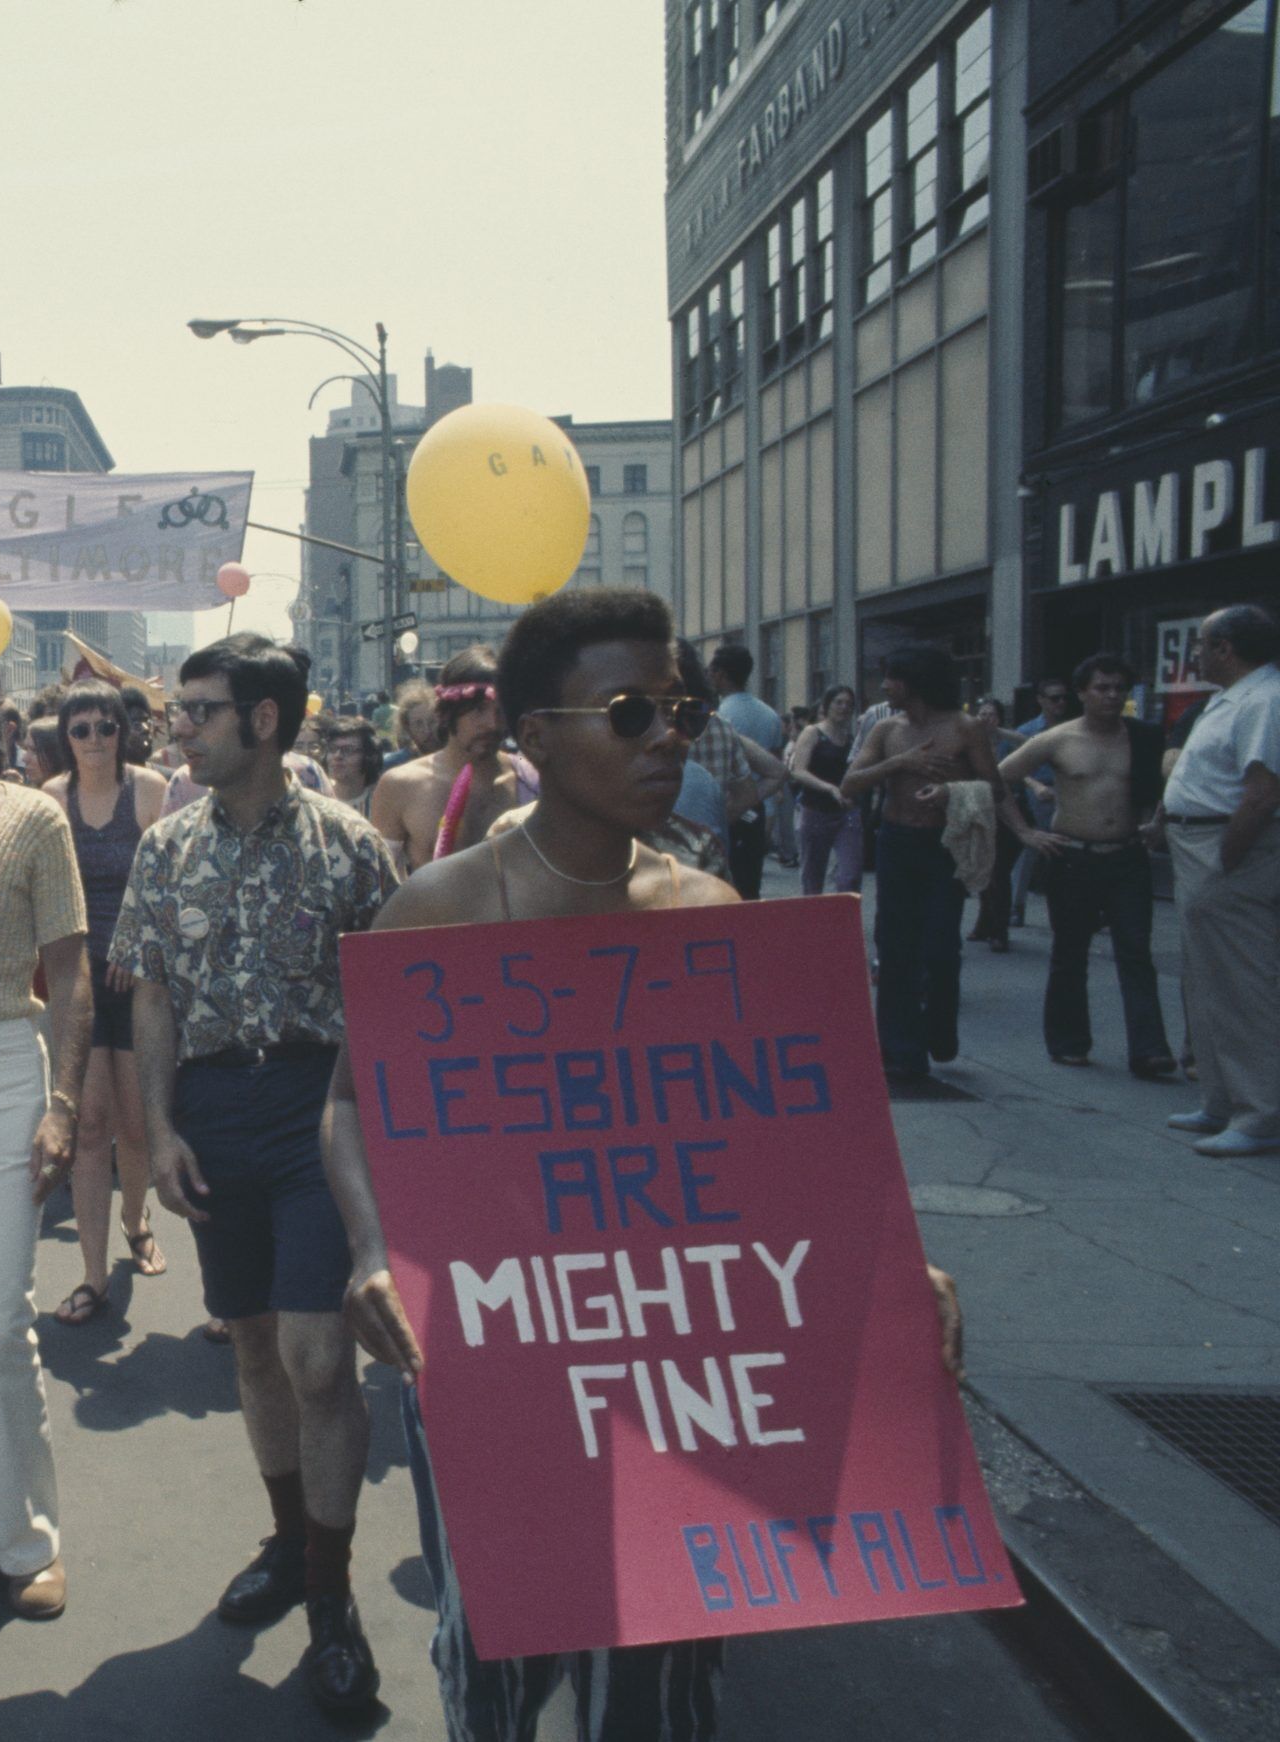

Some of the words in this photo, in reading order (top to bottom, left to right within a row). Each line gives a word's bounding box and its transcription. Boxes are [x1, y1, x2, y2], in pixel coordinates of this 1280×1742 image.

[737, 18, 846, 198] FARBAND
[403, 939, 744, 1042] 3-5-7-9
[375, 1035, 832, 1139] LESBIANS
[537, 1141, 741, 1233] ARE
[449, 1240, 811, 1346] MIGHTY
[568, 1353, 805, 1458] FINE
